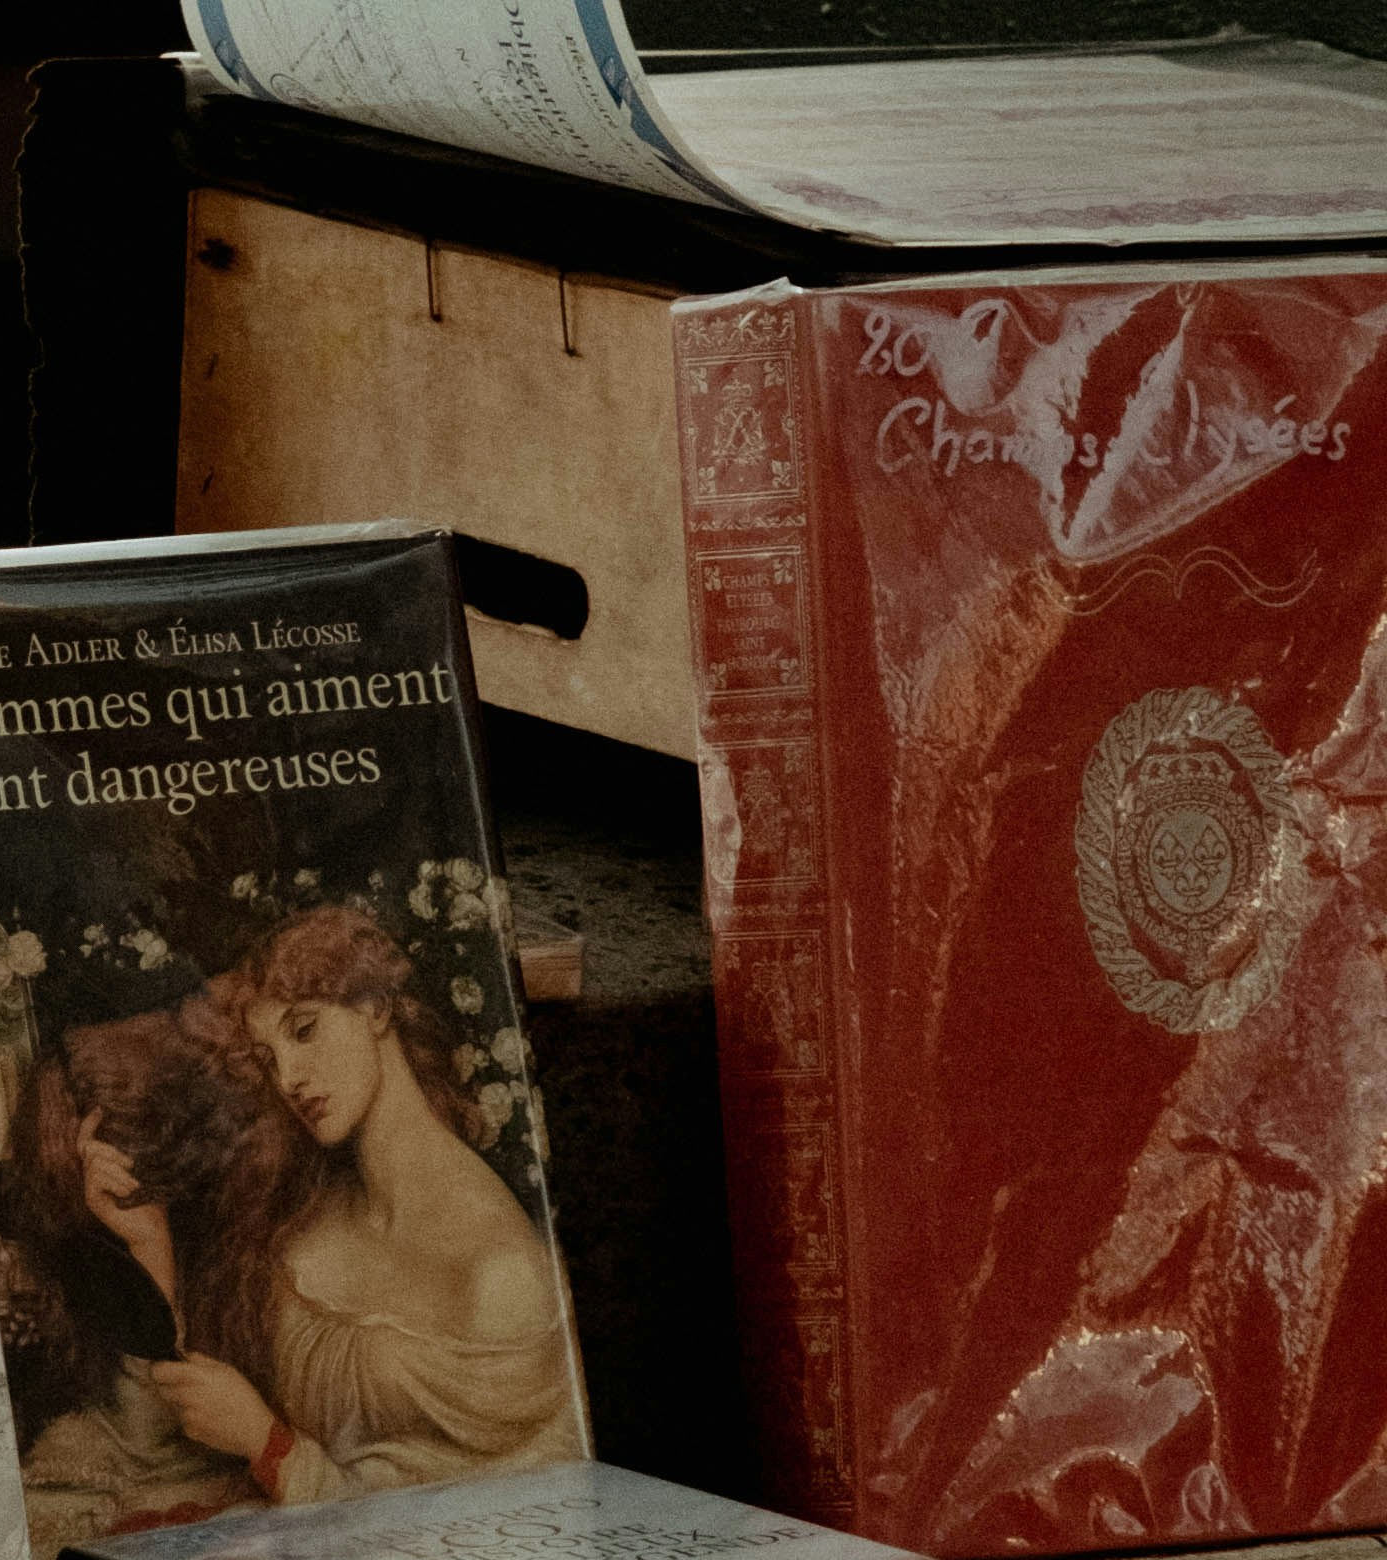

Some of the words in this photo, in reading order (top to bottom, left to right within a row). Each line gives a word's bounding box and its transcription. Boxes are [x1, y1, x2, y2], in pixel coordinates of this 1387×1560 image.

[26, 632, 126, 669] ADLER
[134, 630, 160, 659] &
[165, 667, 253, 742] qui
[265, 660, 456, 718] aiment
[67, 744, 382, 817] dangereuses
[388, 1522, 561, 1558] ECO
